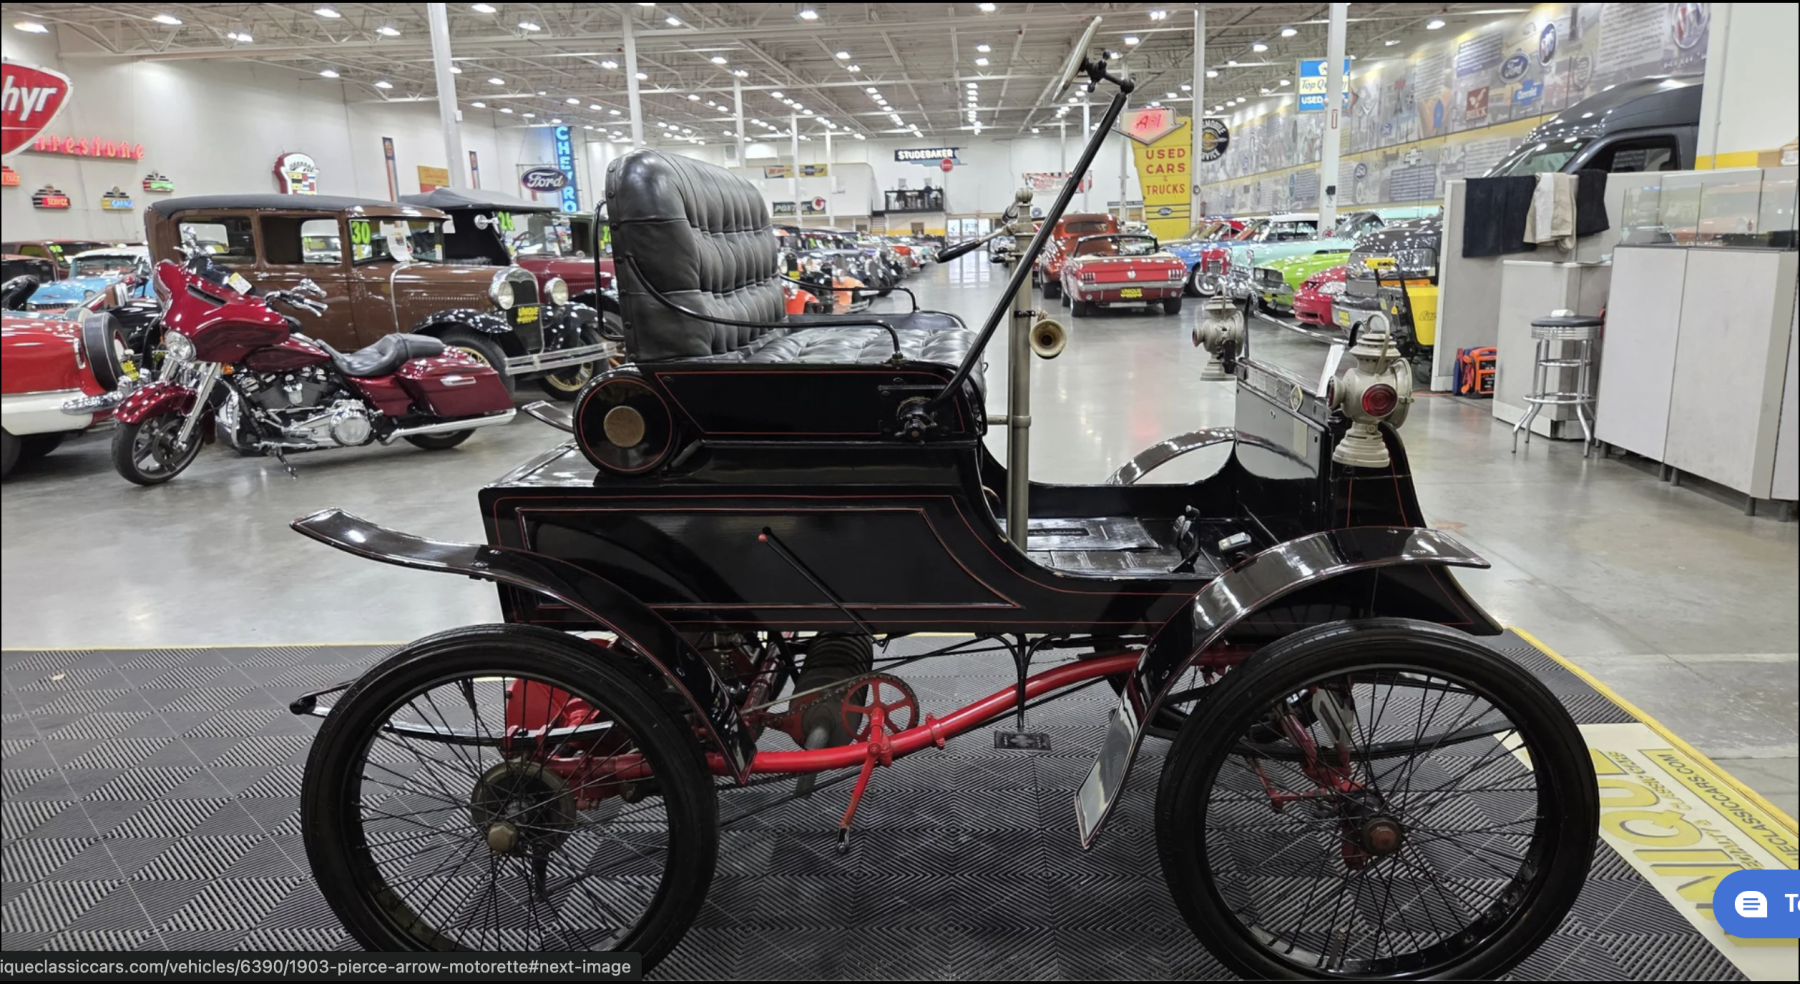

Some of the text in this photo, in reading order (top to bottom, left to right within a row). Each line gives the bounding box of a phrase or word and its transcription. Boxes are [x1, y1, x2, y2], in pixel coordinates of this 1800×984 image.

[1302, 79, 1316, 91] Top
[2, 75, 58, 121] hyr
[1301, 96, 1323, 104] USED
[1136, 115, 1161, 129] A-1
[897, 149, 953, 160] STUDEBAKER
[1146, 148, 1186, 160] USED
[1146, 163, 1186, 174] CARS
[527, 172, 564, 188] Ford
[1146, 184, 1186, 195] TRUCKS
[775, 204, 811, 212] PONTIC
[498, 211, 514, 231] 26
[351, 221, 370, 244] 30
